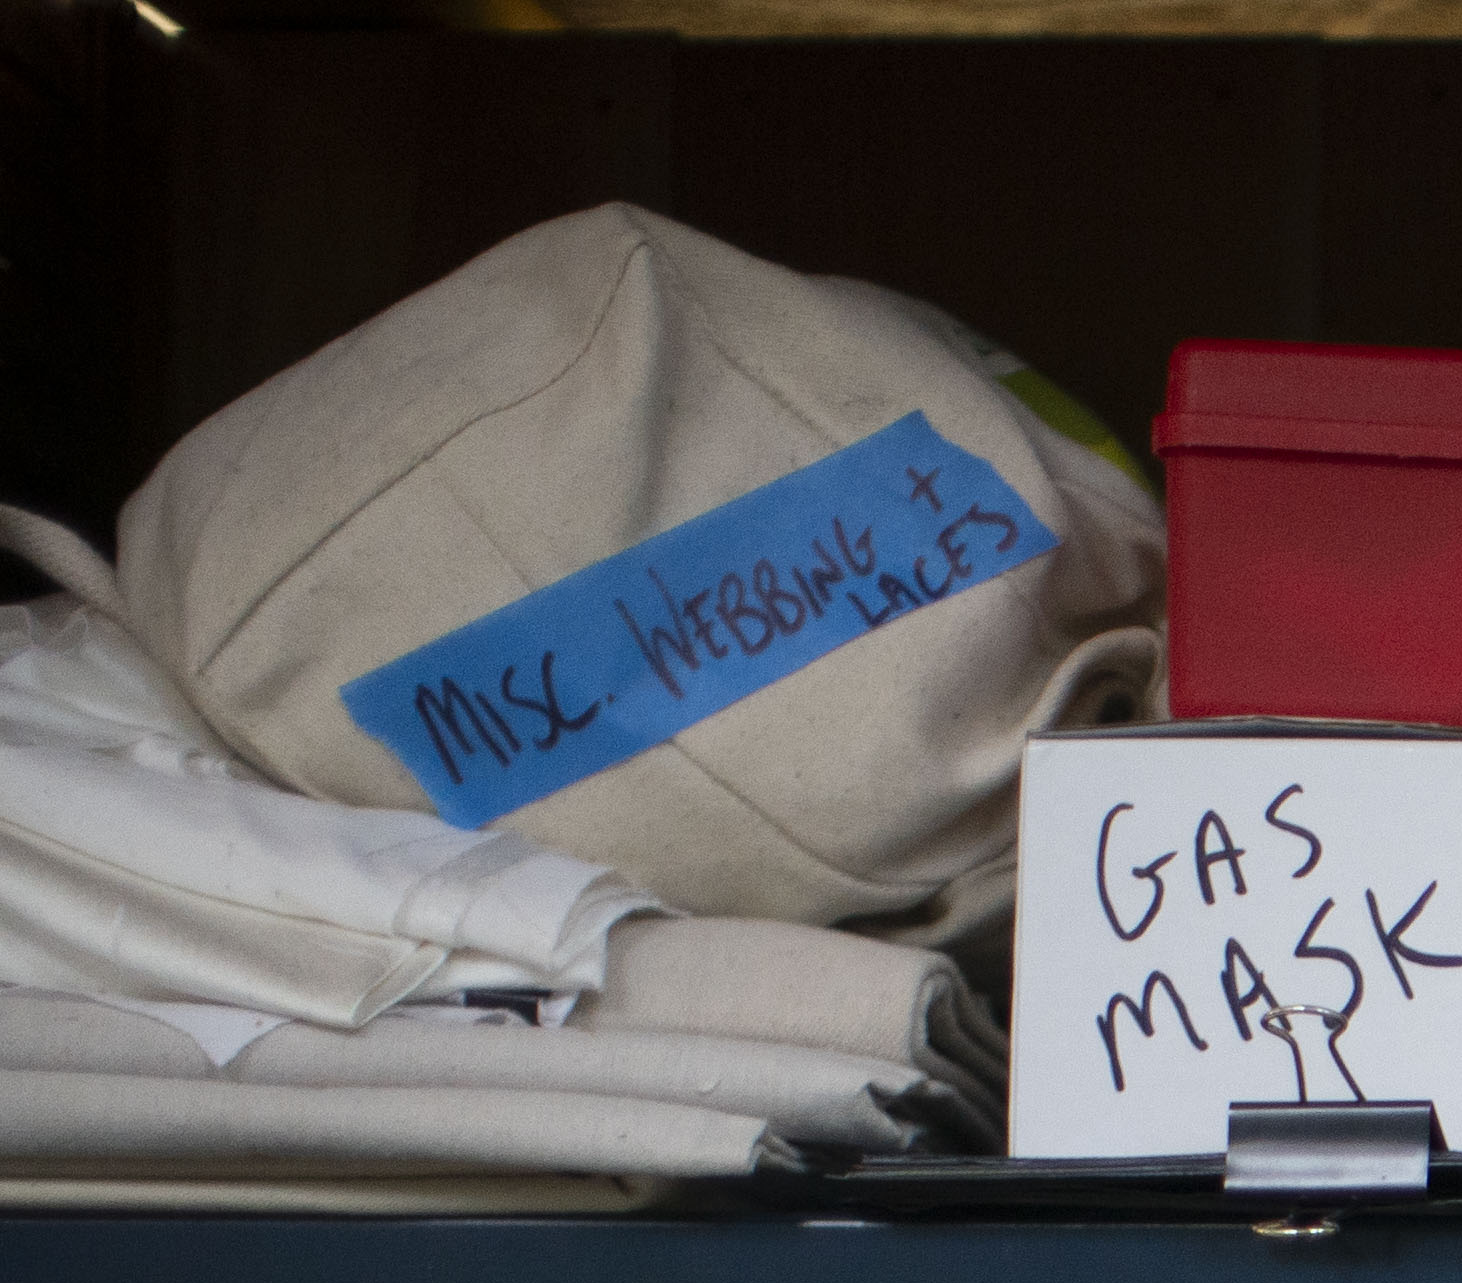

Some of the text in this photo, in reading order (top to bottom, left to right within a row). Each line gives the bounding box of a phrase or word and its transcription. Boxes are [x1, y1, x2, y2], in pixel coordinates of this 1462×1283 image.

[845, 504, 1020, 630] LACES
[414, 651, 616, 785] MISC.
[615, 517, 879, 700] WEBBING
[1096, 783, 1323, 942] GAS
